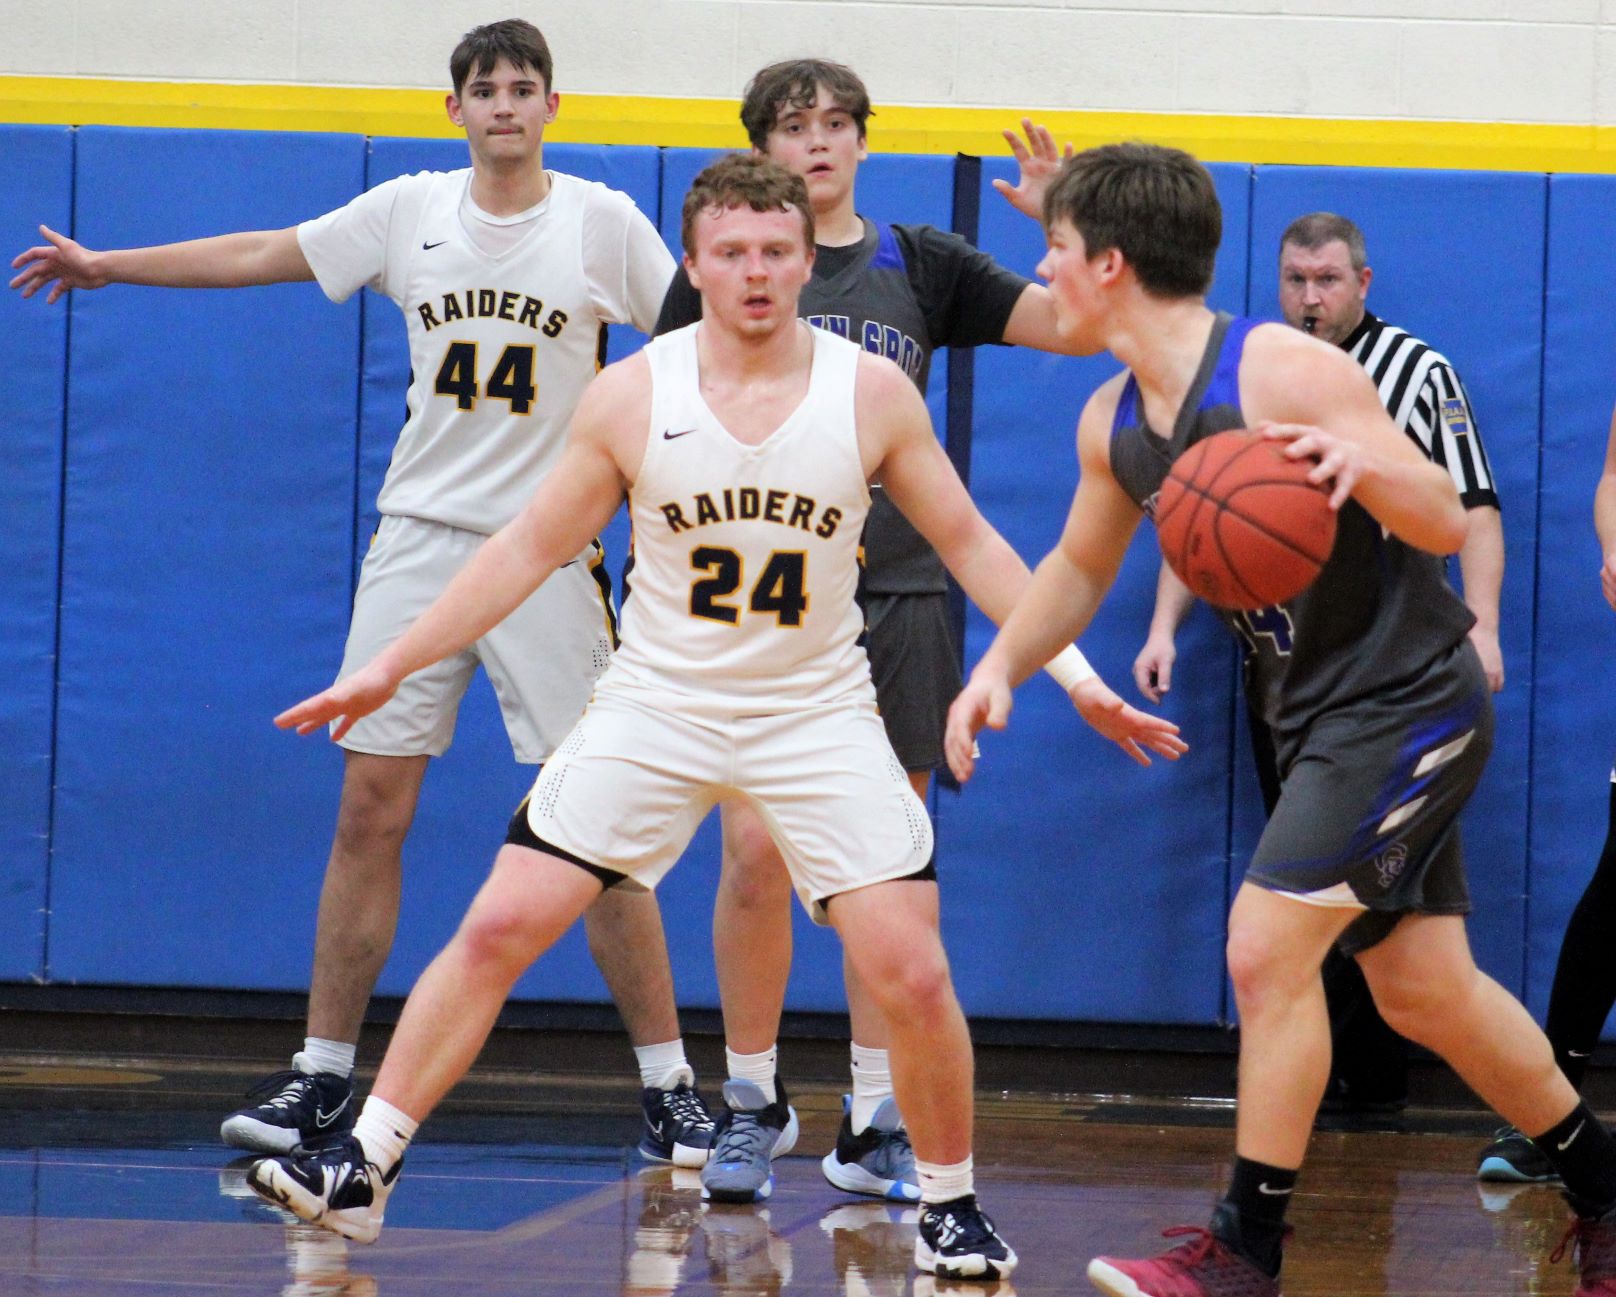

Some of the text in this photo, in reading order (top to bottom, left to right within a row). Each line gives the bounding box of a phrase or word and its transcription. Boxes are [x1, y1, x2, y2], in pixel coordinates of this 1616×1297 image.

[417, 288, 569, 339] RAIDERS
[433, 340, 538, 416] 44
[659, 487, 843, 540] RAIDERS
[688, 544, 810, 629] 24
